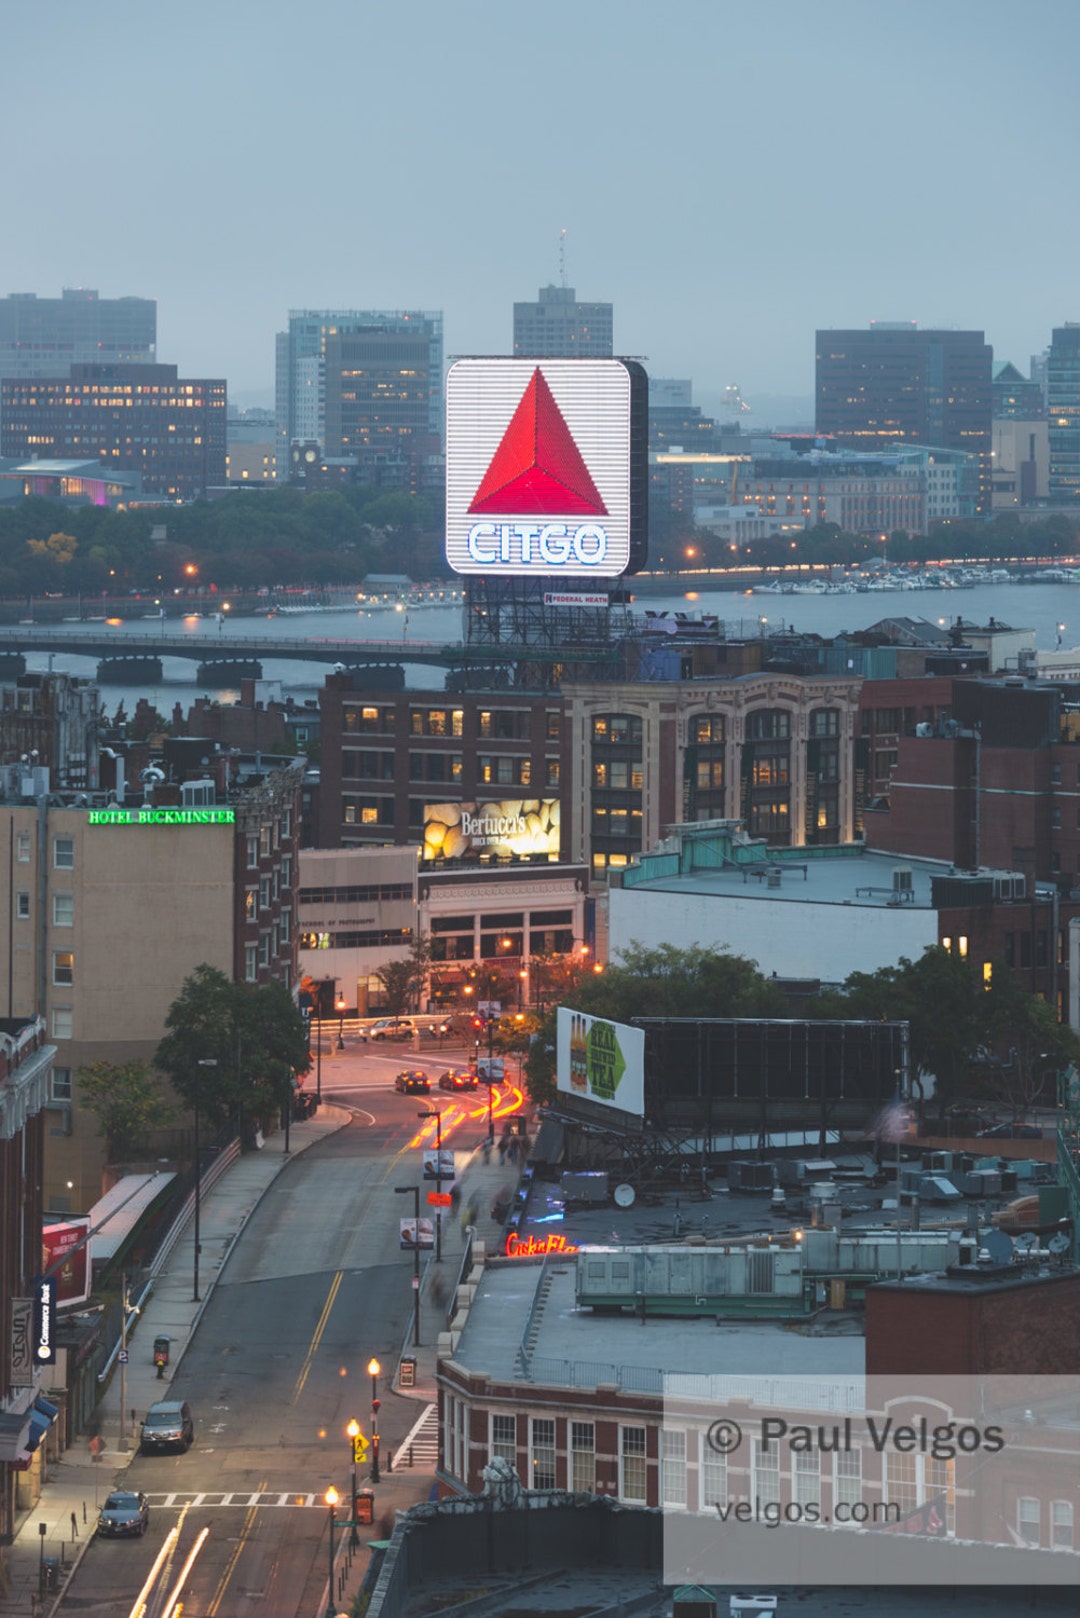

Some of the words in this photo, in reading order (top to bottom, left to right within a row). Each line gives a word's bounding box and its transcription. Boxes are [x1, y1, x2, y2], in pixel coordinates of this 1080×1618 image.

[467, 522, 608, 566] CITGO
[89, 810, 134, 825] HOTEL
[138, 810, 236, 824] BUCKMINSTER
[461, 811, 527, 836] Bertucci's
[591, 1028, 616, 1053] REAL
[591, 1062, 616, 1092] TEA
[546, 1234, 579, 1255] Fla
[41, 1283, 50, 1304] Bank
[40, 1305, 49, 1346] Commerce
